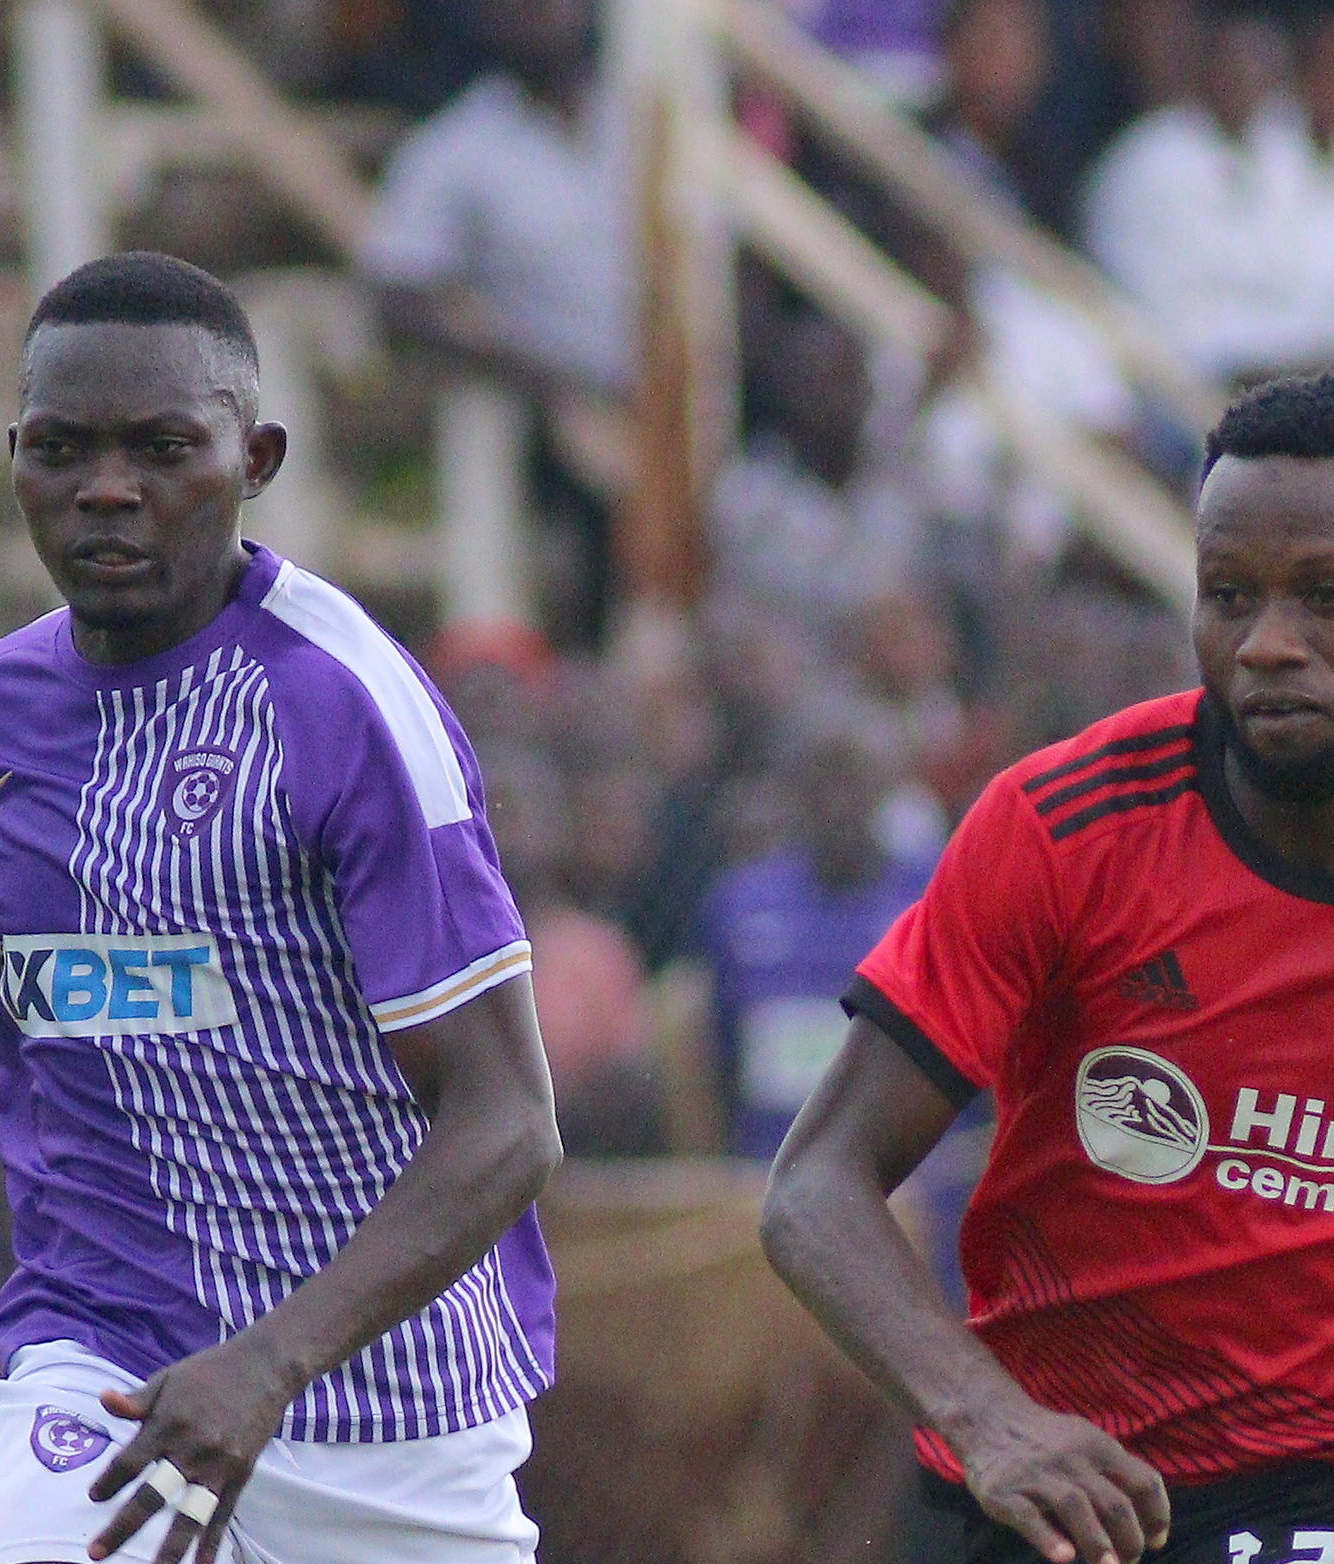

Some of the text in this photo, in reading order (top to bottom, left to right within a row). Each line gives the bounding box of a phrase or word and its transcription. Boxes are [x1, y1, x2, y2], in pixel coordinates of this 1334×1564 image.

[180, 822, 194, 834] FC
[3, 946, 210, 1022] XBET
[52, 1455, 68, 1466] FC
